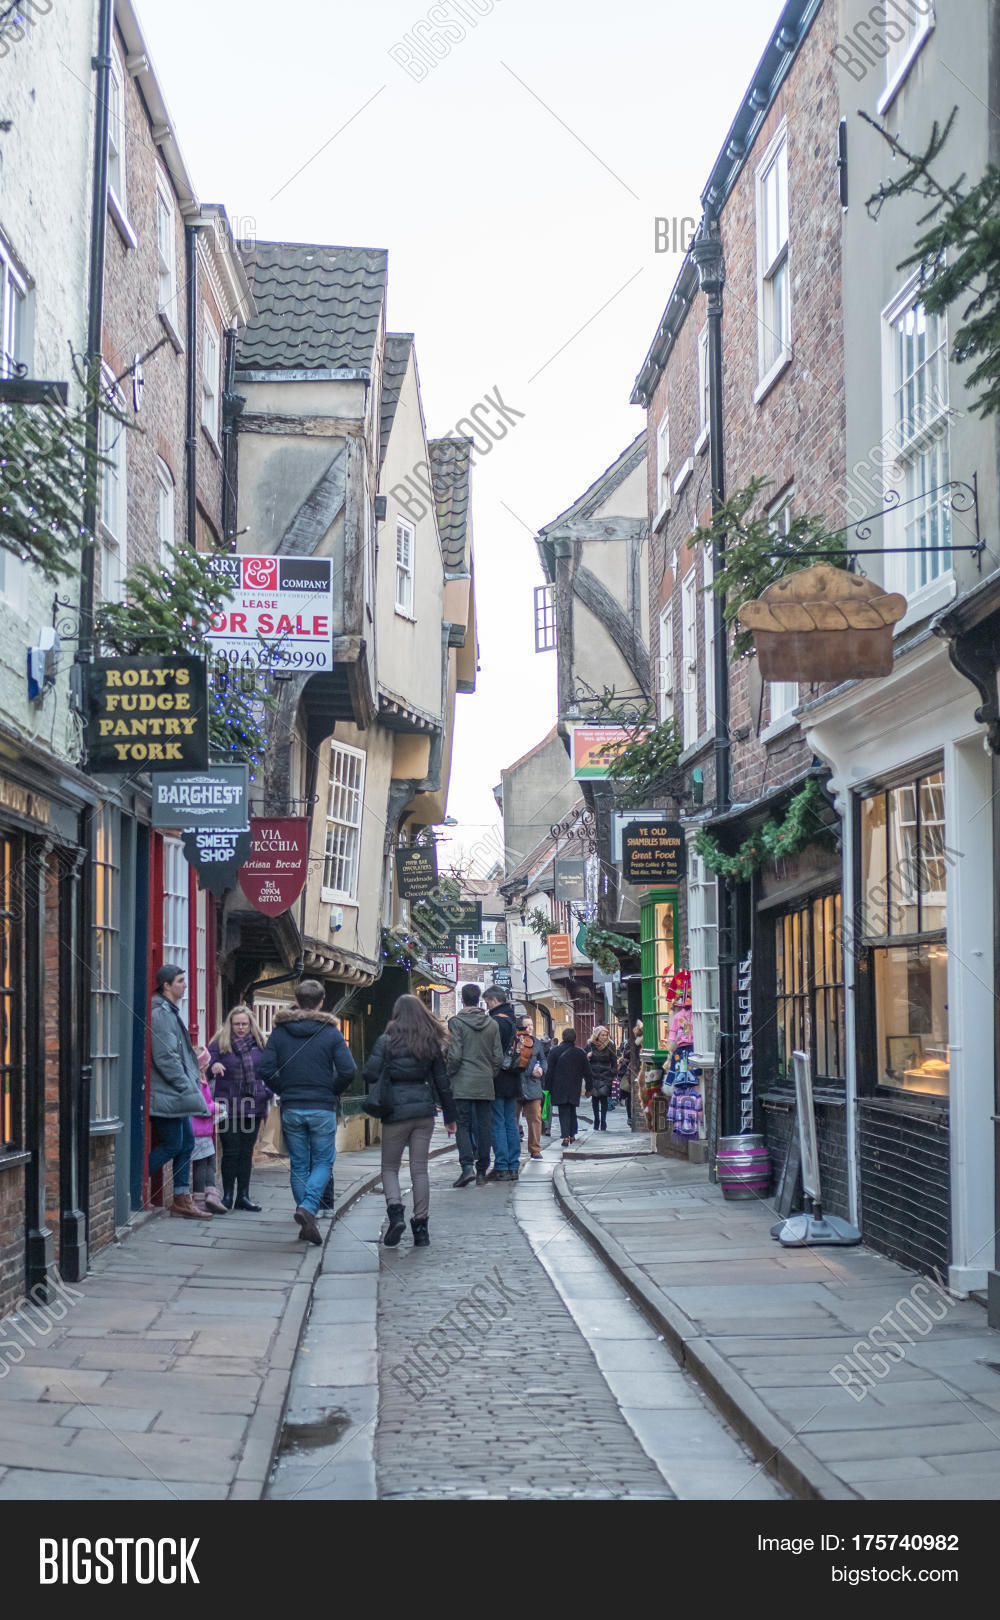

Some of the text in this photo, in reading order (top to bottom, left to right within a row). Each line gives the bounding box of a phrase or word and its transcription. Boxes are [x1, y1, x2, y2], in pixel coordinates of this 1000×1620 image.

[282, 579, 328, 589] COMPANY
[242, 600, 278, 609] LEASE
[257, 613, 329, 636] SALE
[105, 668, 190, 687] ROLY'S
[105, 693, 191, 711] FUDGE
[99, 717, 198, 736] PANTRY
[114, 742, 184, 761] YORK
[157, 785, 243, 806] BARGHEST
[261, 829, 282, 840] VIA
[639, 828, 667, 836] YE OLD
[196, 834, 239, 848] SWEET
[627, 837, 681, 847] SHAMBLES TAVERN
[200, 849, 235, 863] SHOP
[631, 850, 676, 860] Great Food
[275, 859, 302, 869] Bread
[264, 880, 276, 888] Tel
